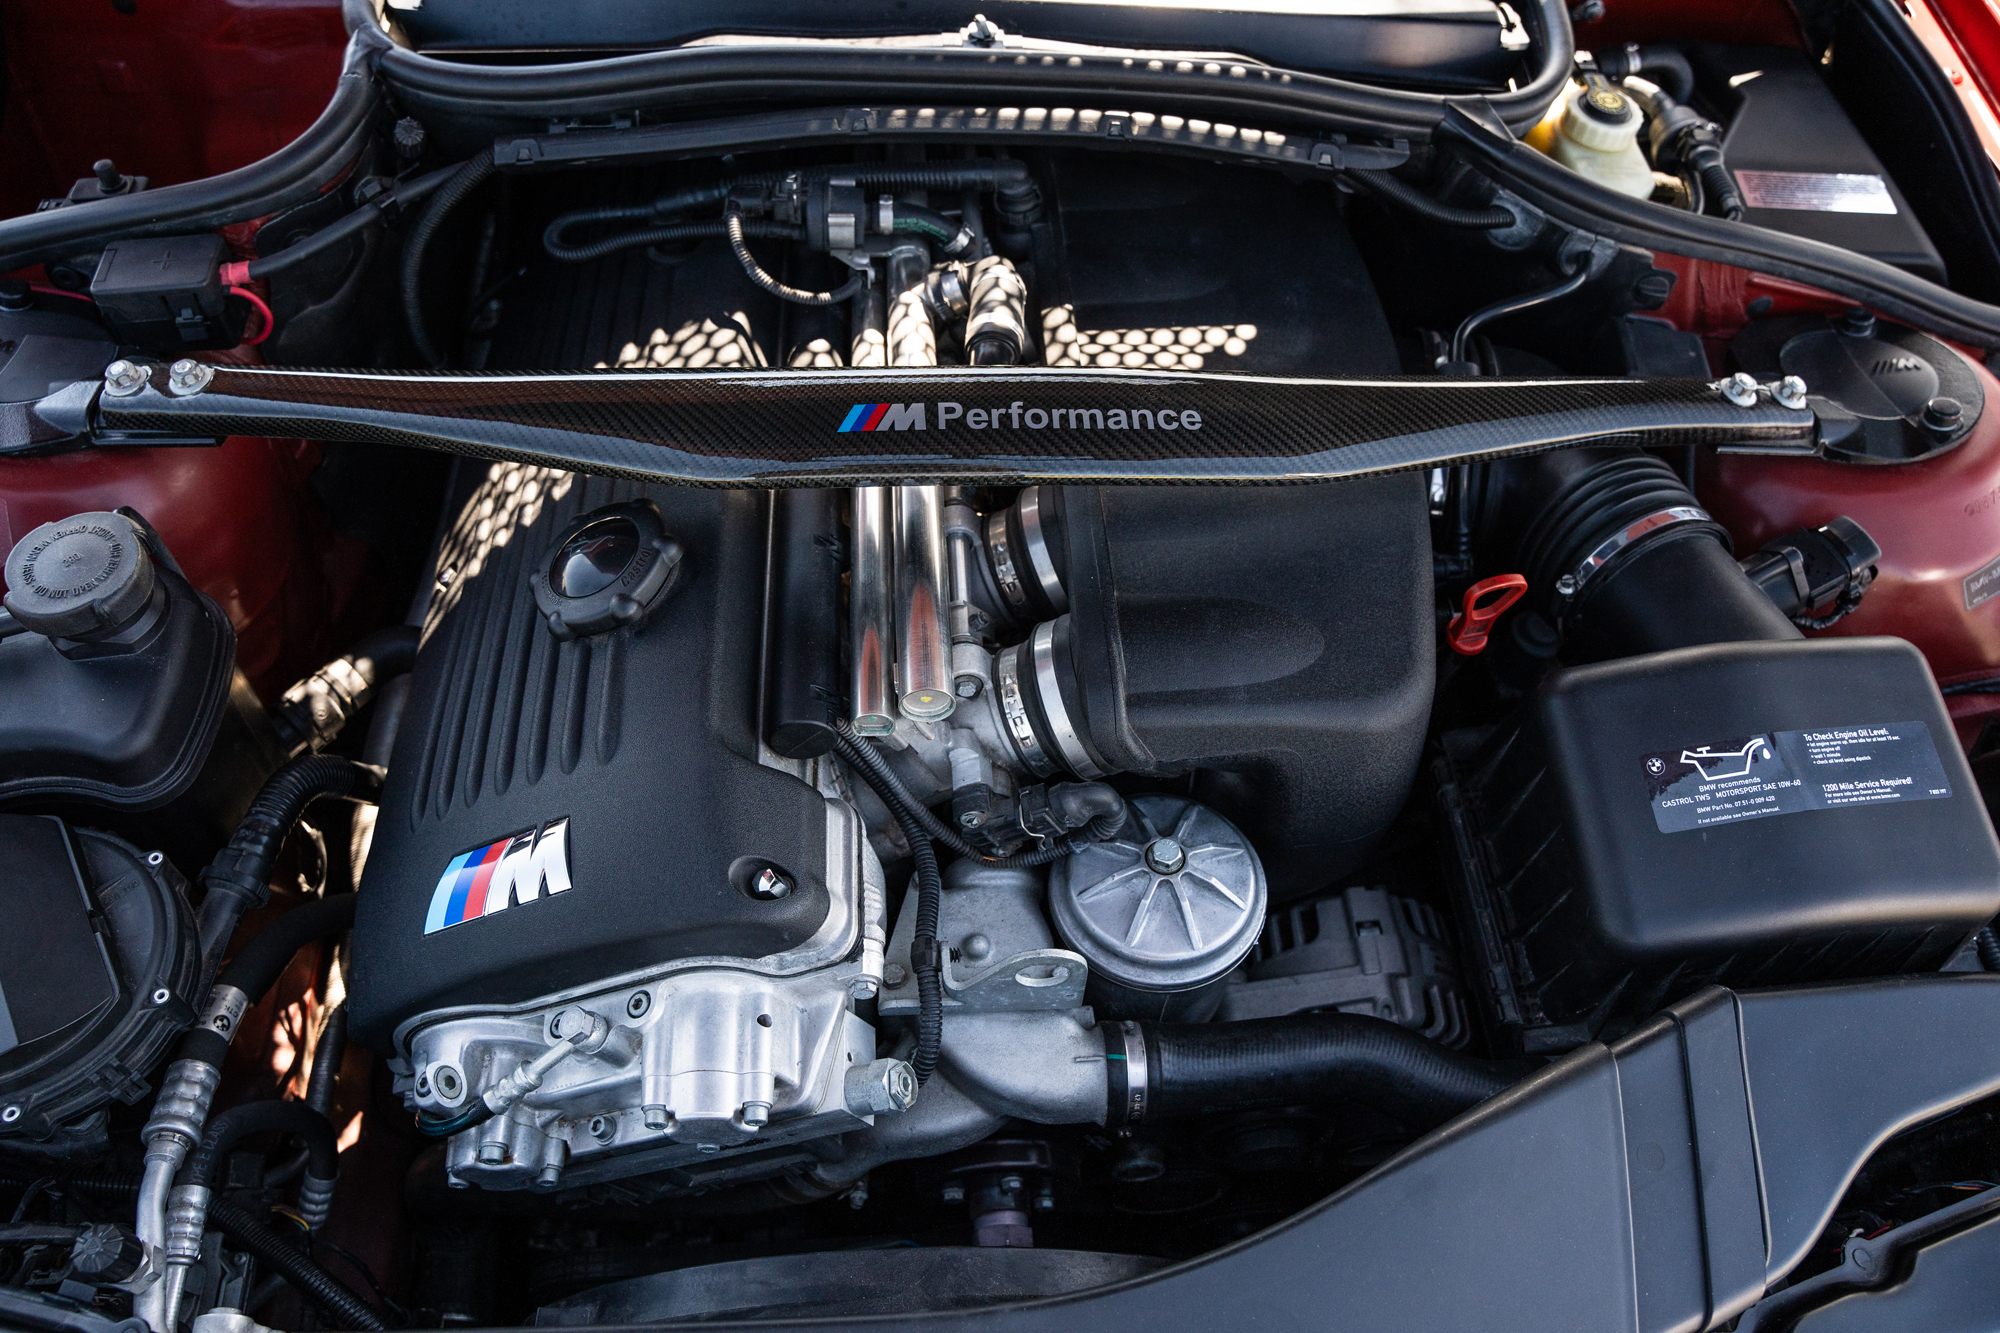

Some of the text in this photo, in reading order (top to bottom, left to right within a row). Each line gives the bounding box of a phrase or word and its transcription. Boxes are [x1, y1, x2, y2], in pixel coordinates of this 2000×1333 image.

[876, 401, 1202, 432] M Performance
[620, 547, 652, 587] Castrol
[1803, 727, 1889, 741] To Check Engine Oil Level:
[1699, 777, 1761, 792] BMW recommends
[1822, 776, 1913, 792] 1200 Mile Service Required!
[1662, 778, 1802, 808] CASTROL TWS MOTORSPORT SAE 10W-60
[1697, 806, 1711, 814] BMW
[1712, 803, 1724, 811] Part
[1711, 814, 1732, 822] available
[1742, 809, 1762, 817] Owner's
